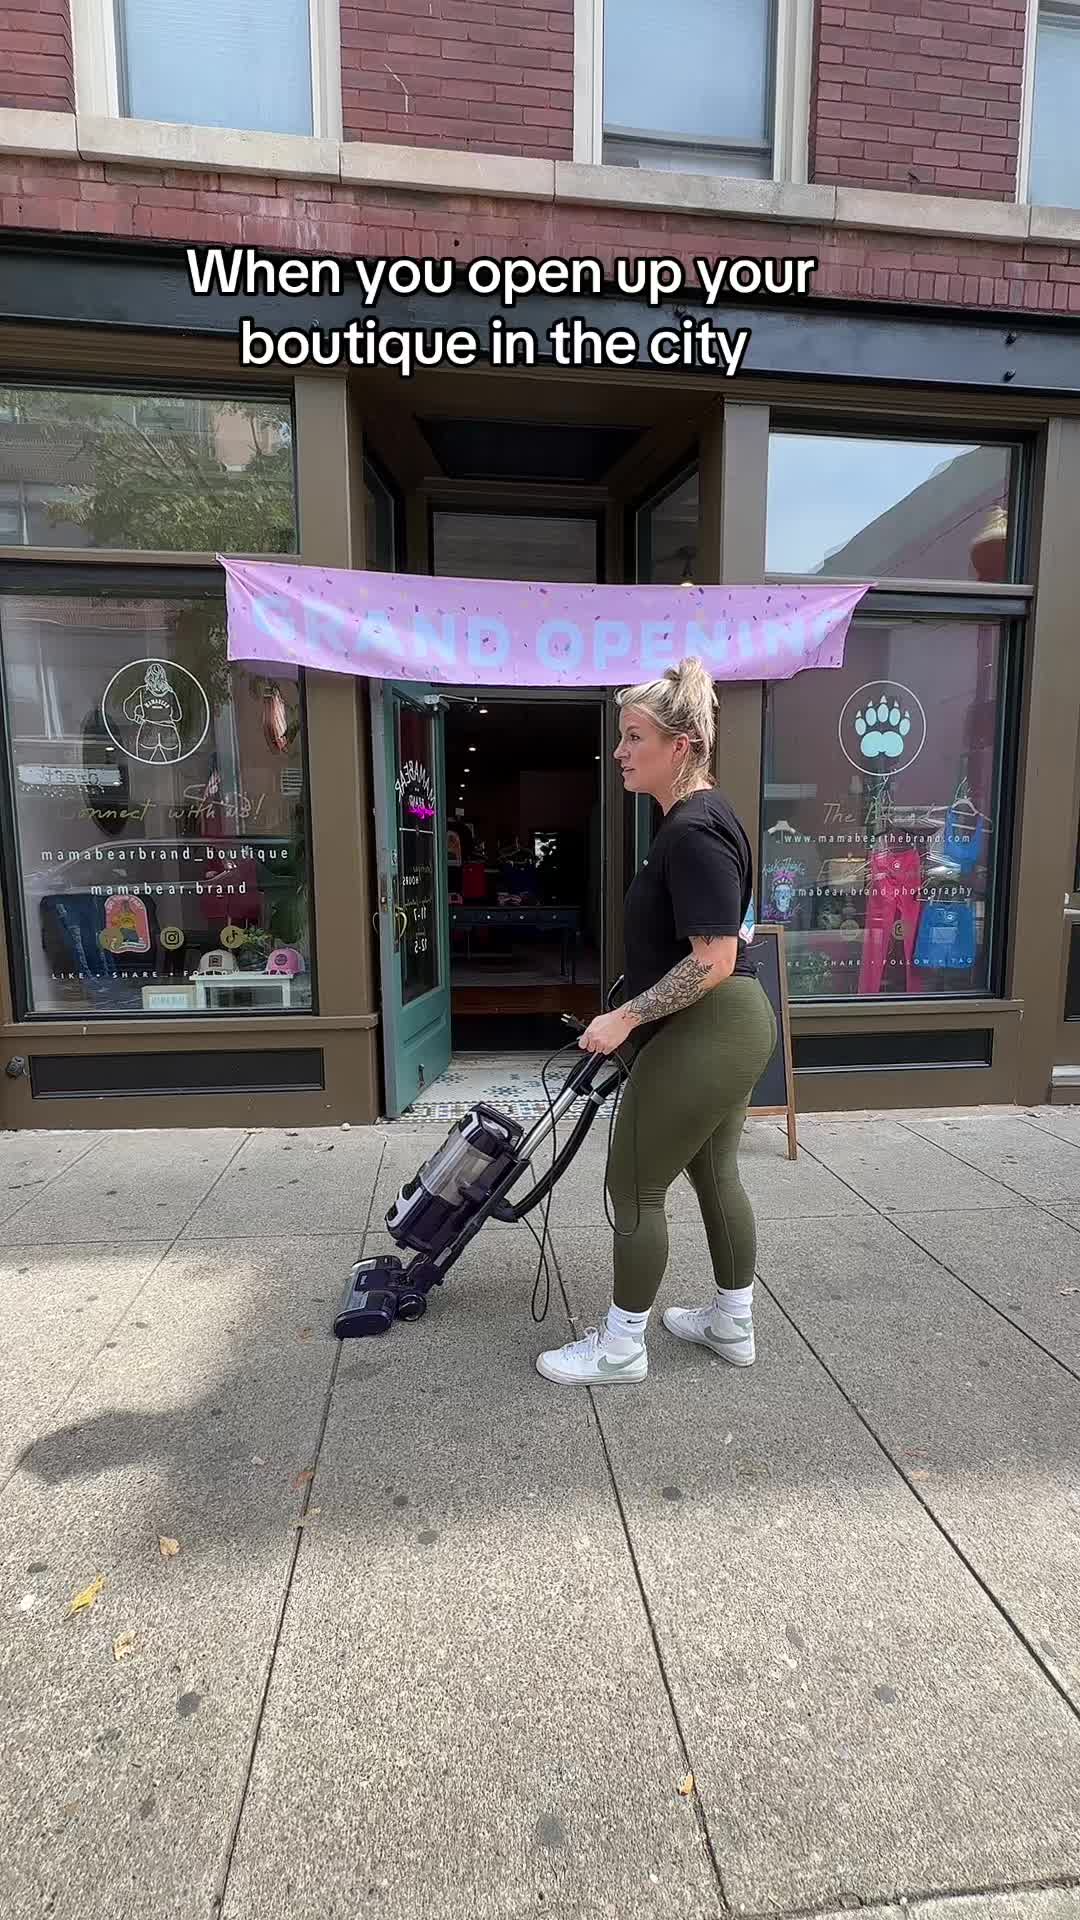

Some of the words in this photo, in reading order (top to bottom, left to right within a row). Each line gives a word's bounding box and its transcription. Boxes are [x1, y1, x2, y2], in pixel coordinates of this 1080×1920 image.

[250, 595, 511, 669] GRAND
[784, 833, 970, 843] www.mamabearthebrand.com
[41, 847, 289, 861] mamabearbrand_boutique
[90, 881, 247, 895] mamabear.brand
[823, 959, 861, 967] SHARE
[51, 972, 85, 980] LIKE
[112, 970, 159, 979] SHARE
